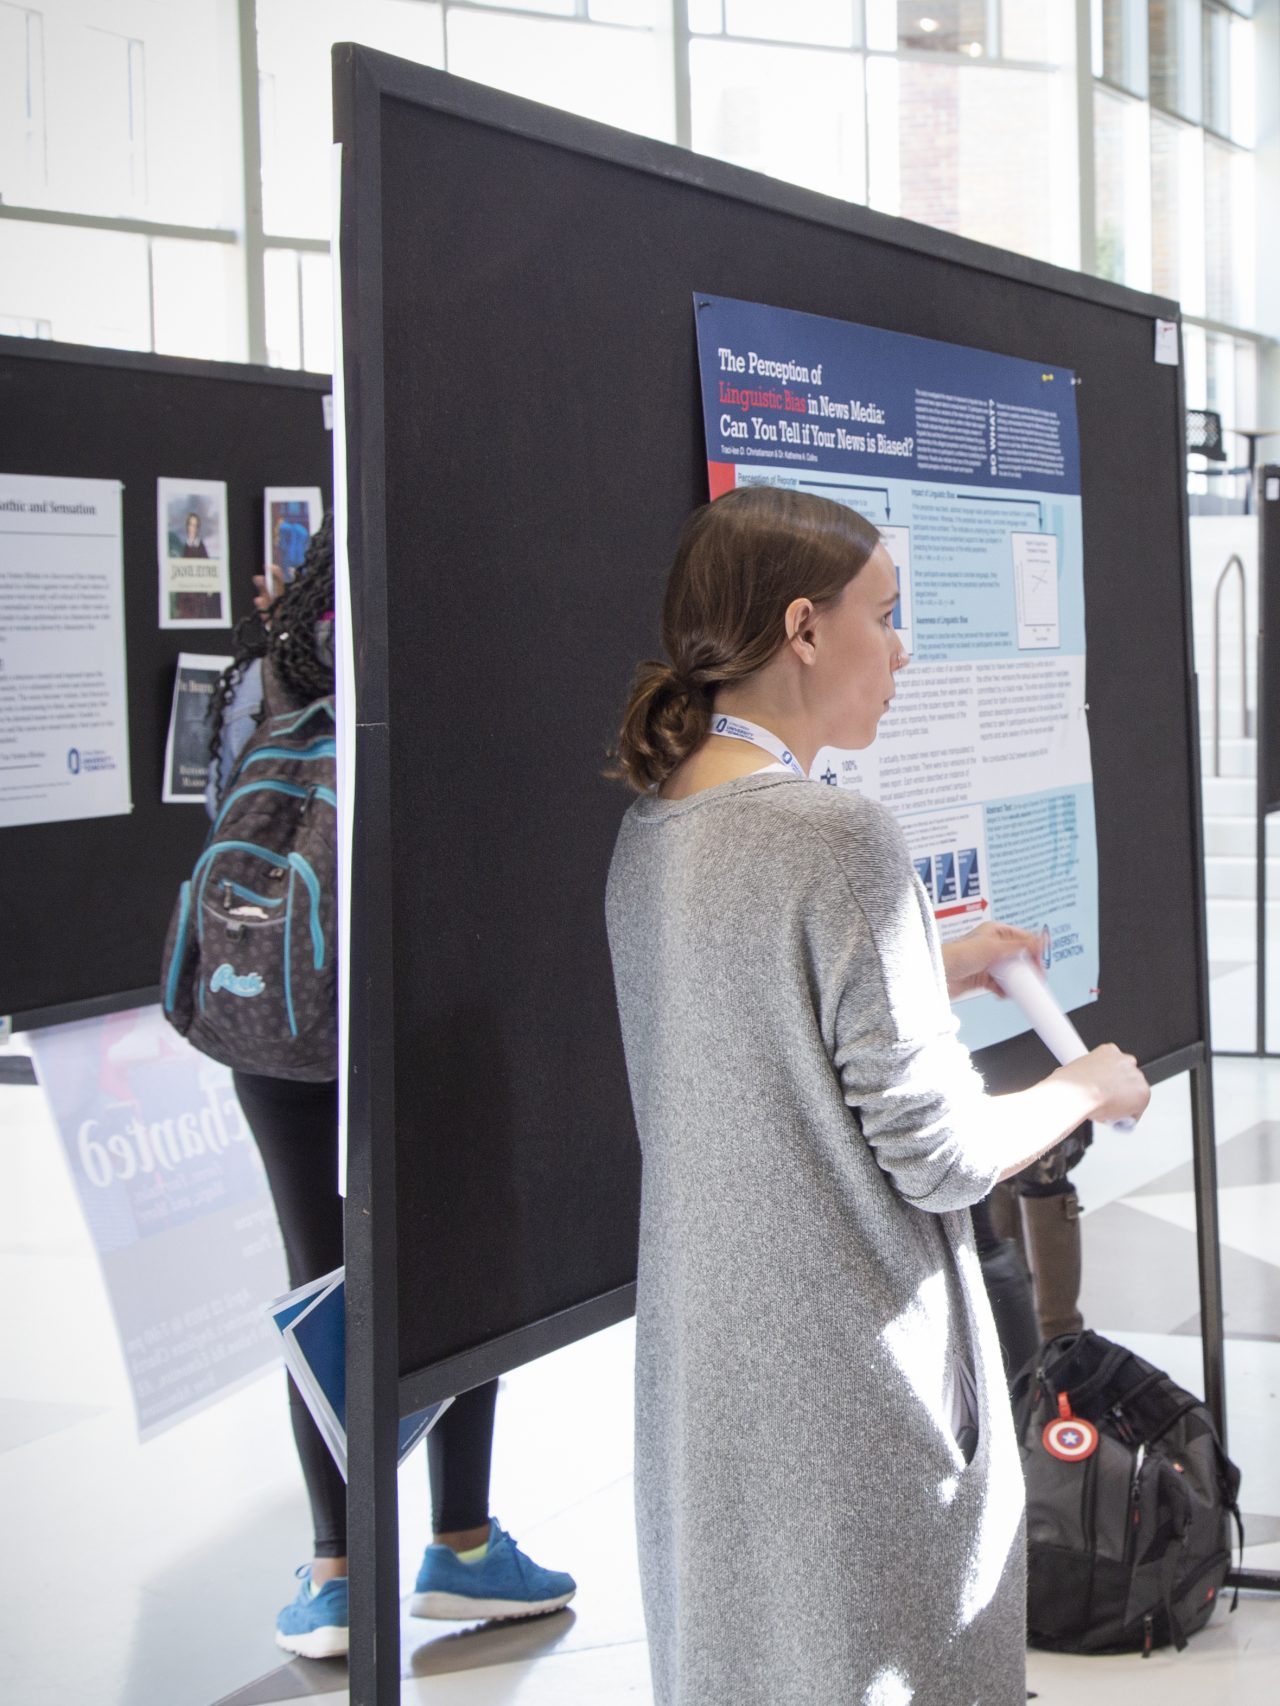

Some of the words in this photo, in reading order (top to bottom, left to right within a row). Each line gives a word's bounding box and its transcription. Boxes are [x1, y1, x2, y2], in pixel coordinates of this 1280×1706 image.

[718, 348, 746, 373] The
[748, 352, 810, 385] Perception
[810, 364, 823, 385] of
[719, 380, 783, 412] Linguistic
[784, 389, 806, 413] Bias
[807, 393, 819, 416] in
[819, 395, 850, 421] News
[850, 400, 885, 425] Media:
[719, 414, 749, 438] Can
[751, 417, 778, 441] You
[778, 420, 801, 444] Tell
[802, 423, 810, 445] if
[810, 425, 836, 448] Your
[836, 428, 866, 451] News
[866, 432, 876, 452] is
[877, 433, 914, 457] Biased?
[737, 472, 769, 483] Perception
